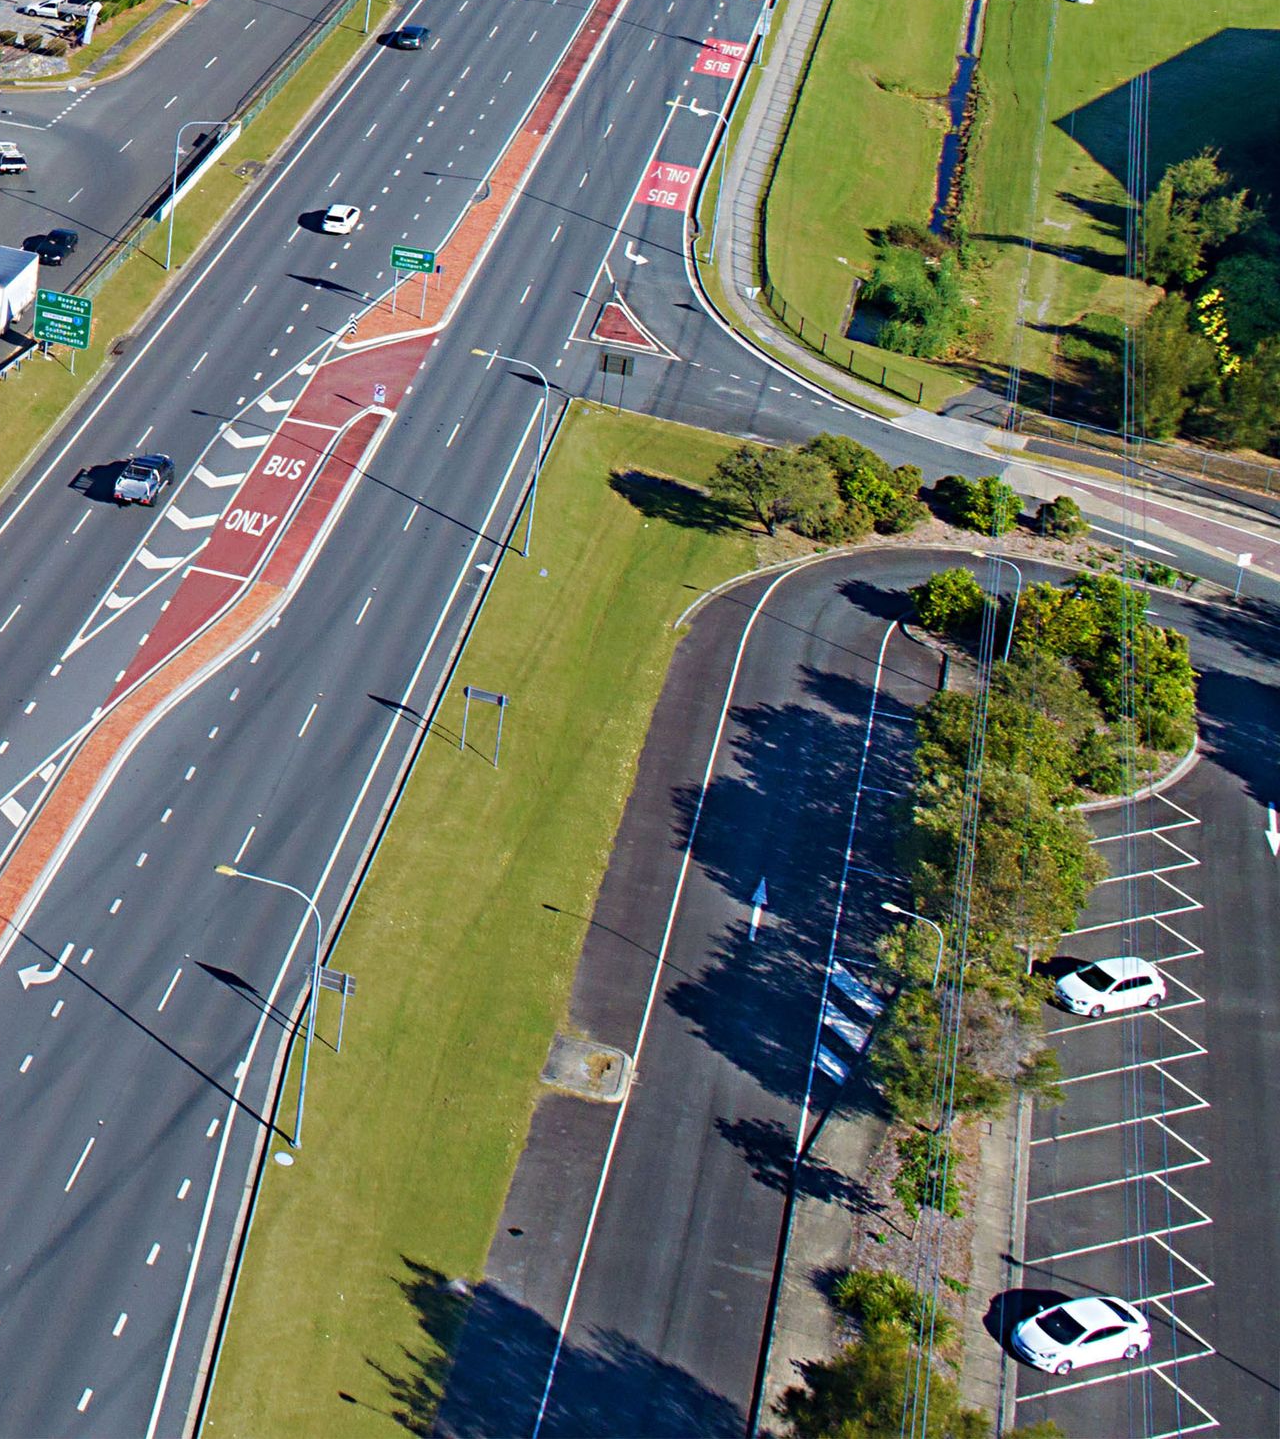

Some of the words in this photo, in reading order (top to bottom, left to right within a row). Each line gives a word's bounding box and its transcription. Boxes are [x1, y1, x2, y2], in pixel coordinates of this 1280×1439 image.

[703, 59, 731, 74] BUS
[651, 165, 690, 185] ONLY
[647, 188, 679, 206] BUS
[262, 455, 306, 480] BUS
[224, 508, 279, 538] ONLY
